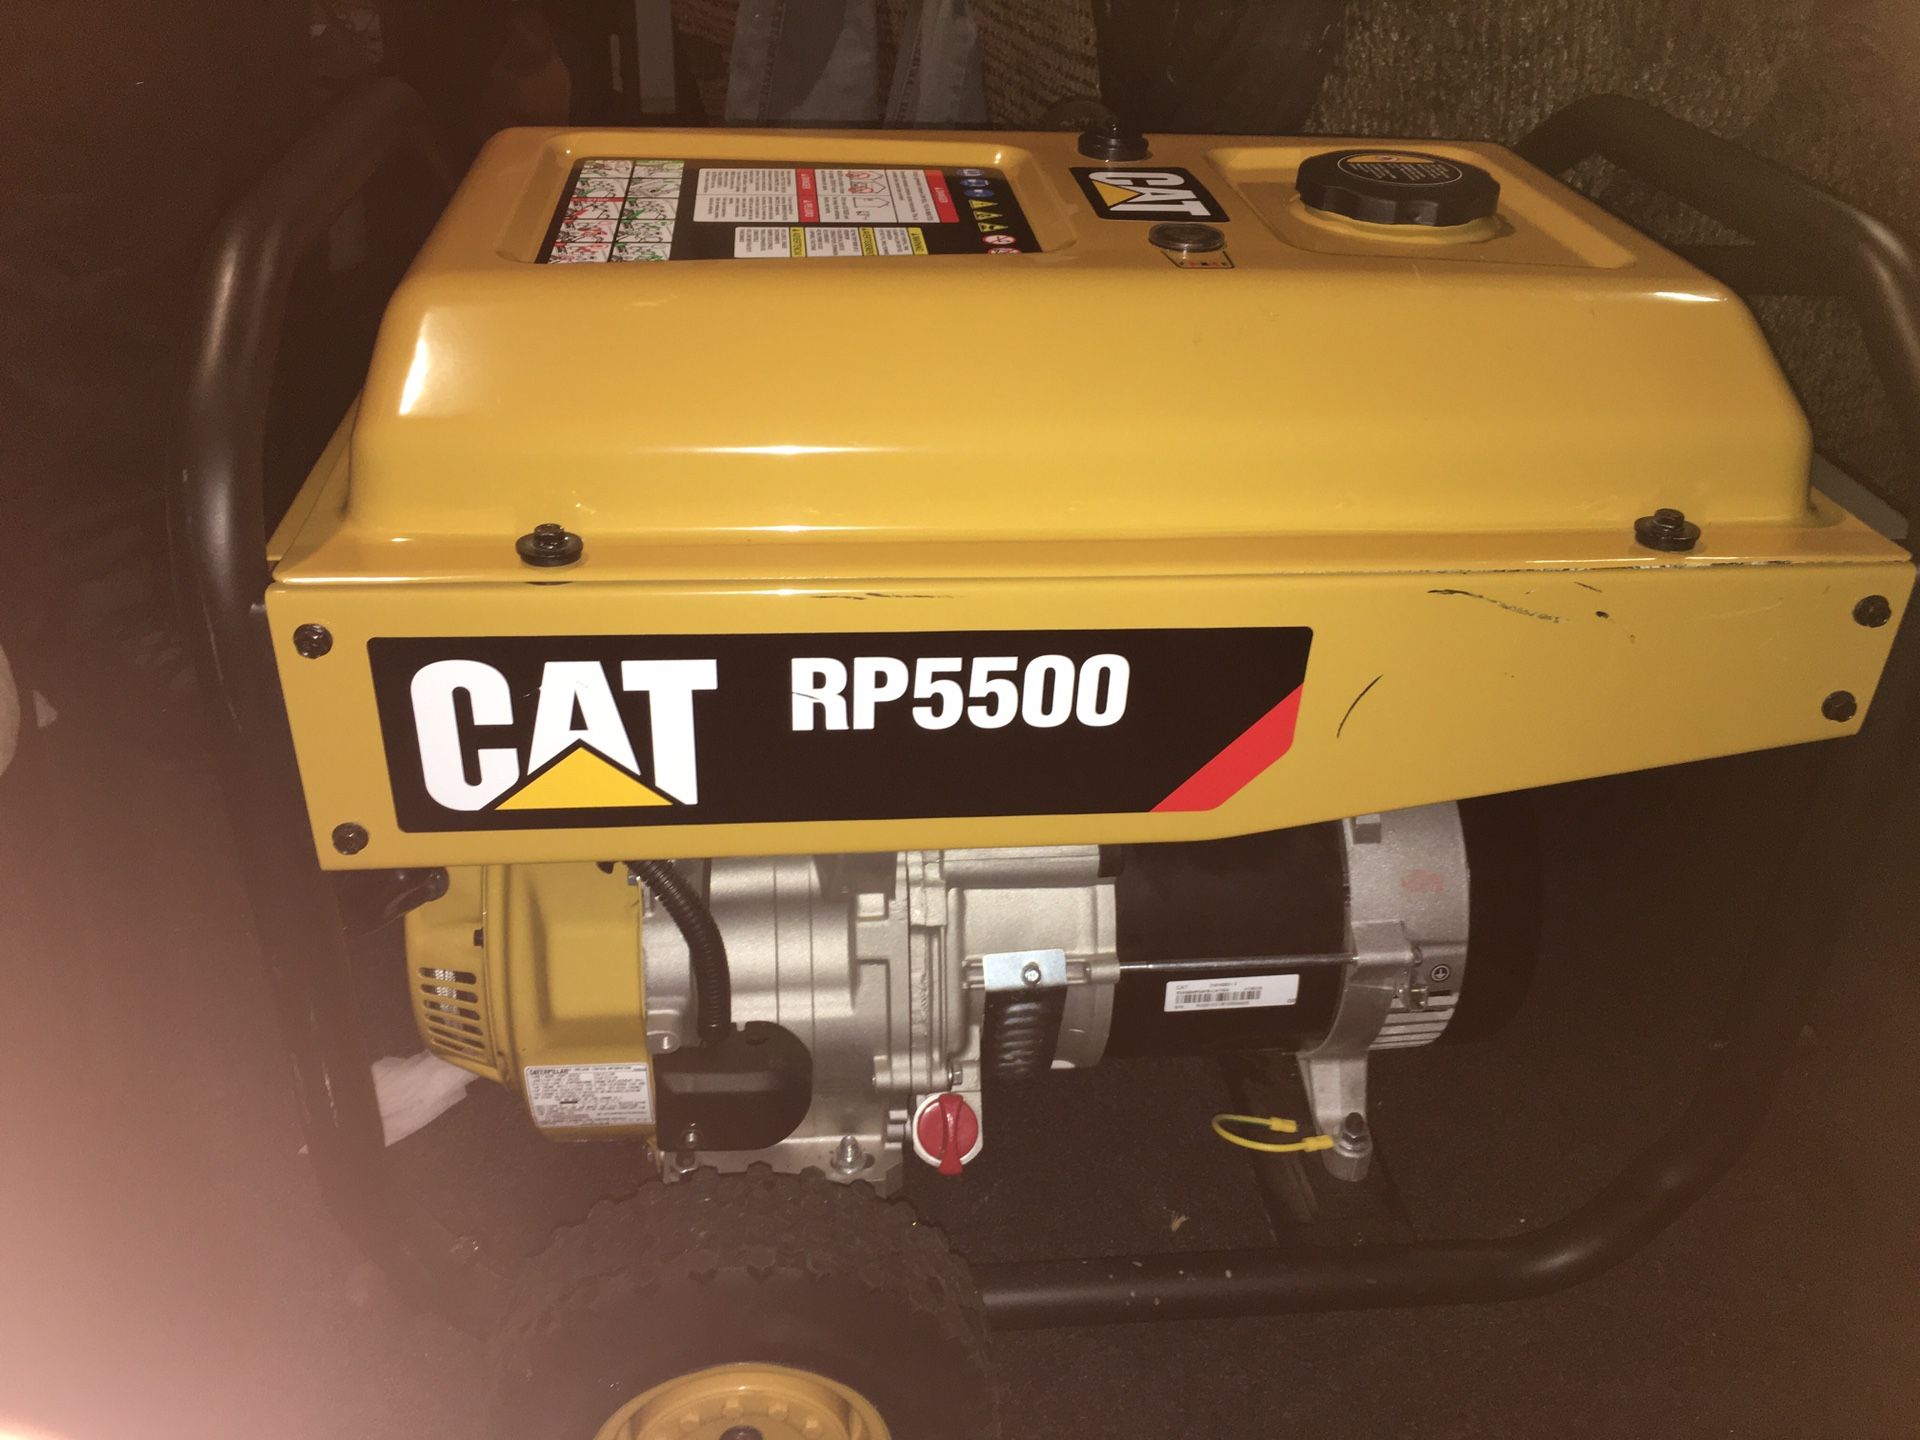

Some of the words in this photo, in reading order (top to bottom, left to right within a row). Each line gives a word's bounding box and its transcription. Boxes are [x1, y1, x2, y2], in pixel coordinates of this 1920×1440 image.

[1088, 171, 1211, 216] CAT
[791, 653, 1130, 731] RP5500
[410, 659, 718, 811] CAT
